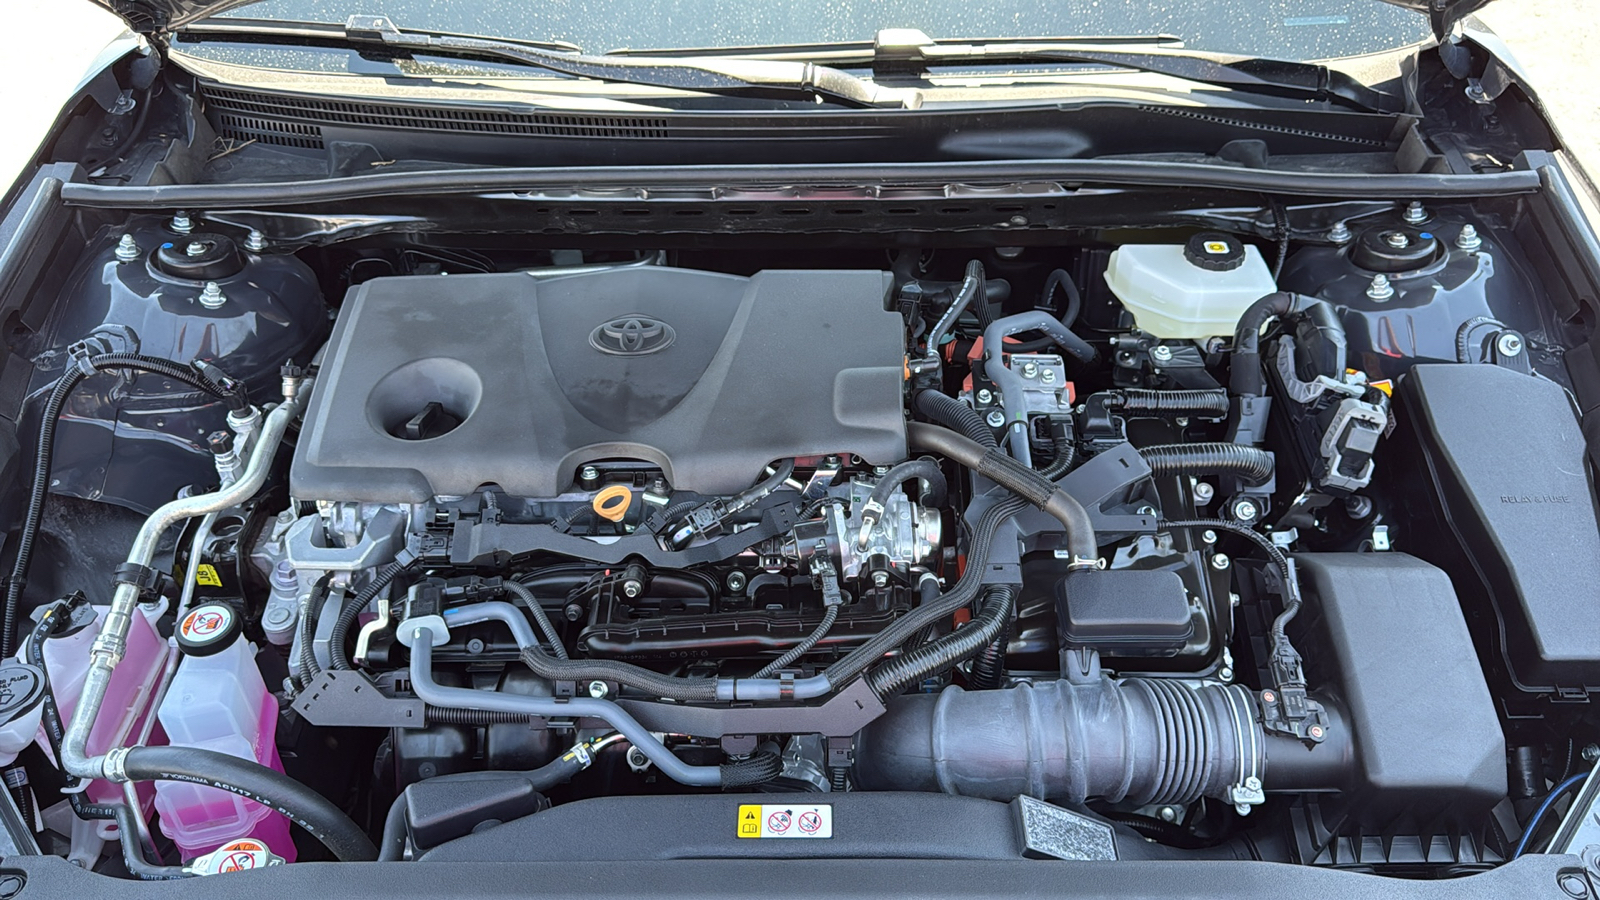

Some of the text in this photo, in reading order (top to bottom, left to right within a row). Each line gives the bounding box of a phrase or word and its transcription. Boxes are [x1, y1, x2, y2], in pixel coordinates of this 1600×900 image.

[1500, 495, 1571, 504] RELAY & FUSE
[51, 719, 61, 740] WATER
[167, 773, 209, 784] YOKOHAMA
